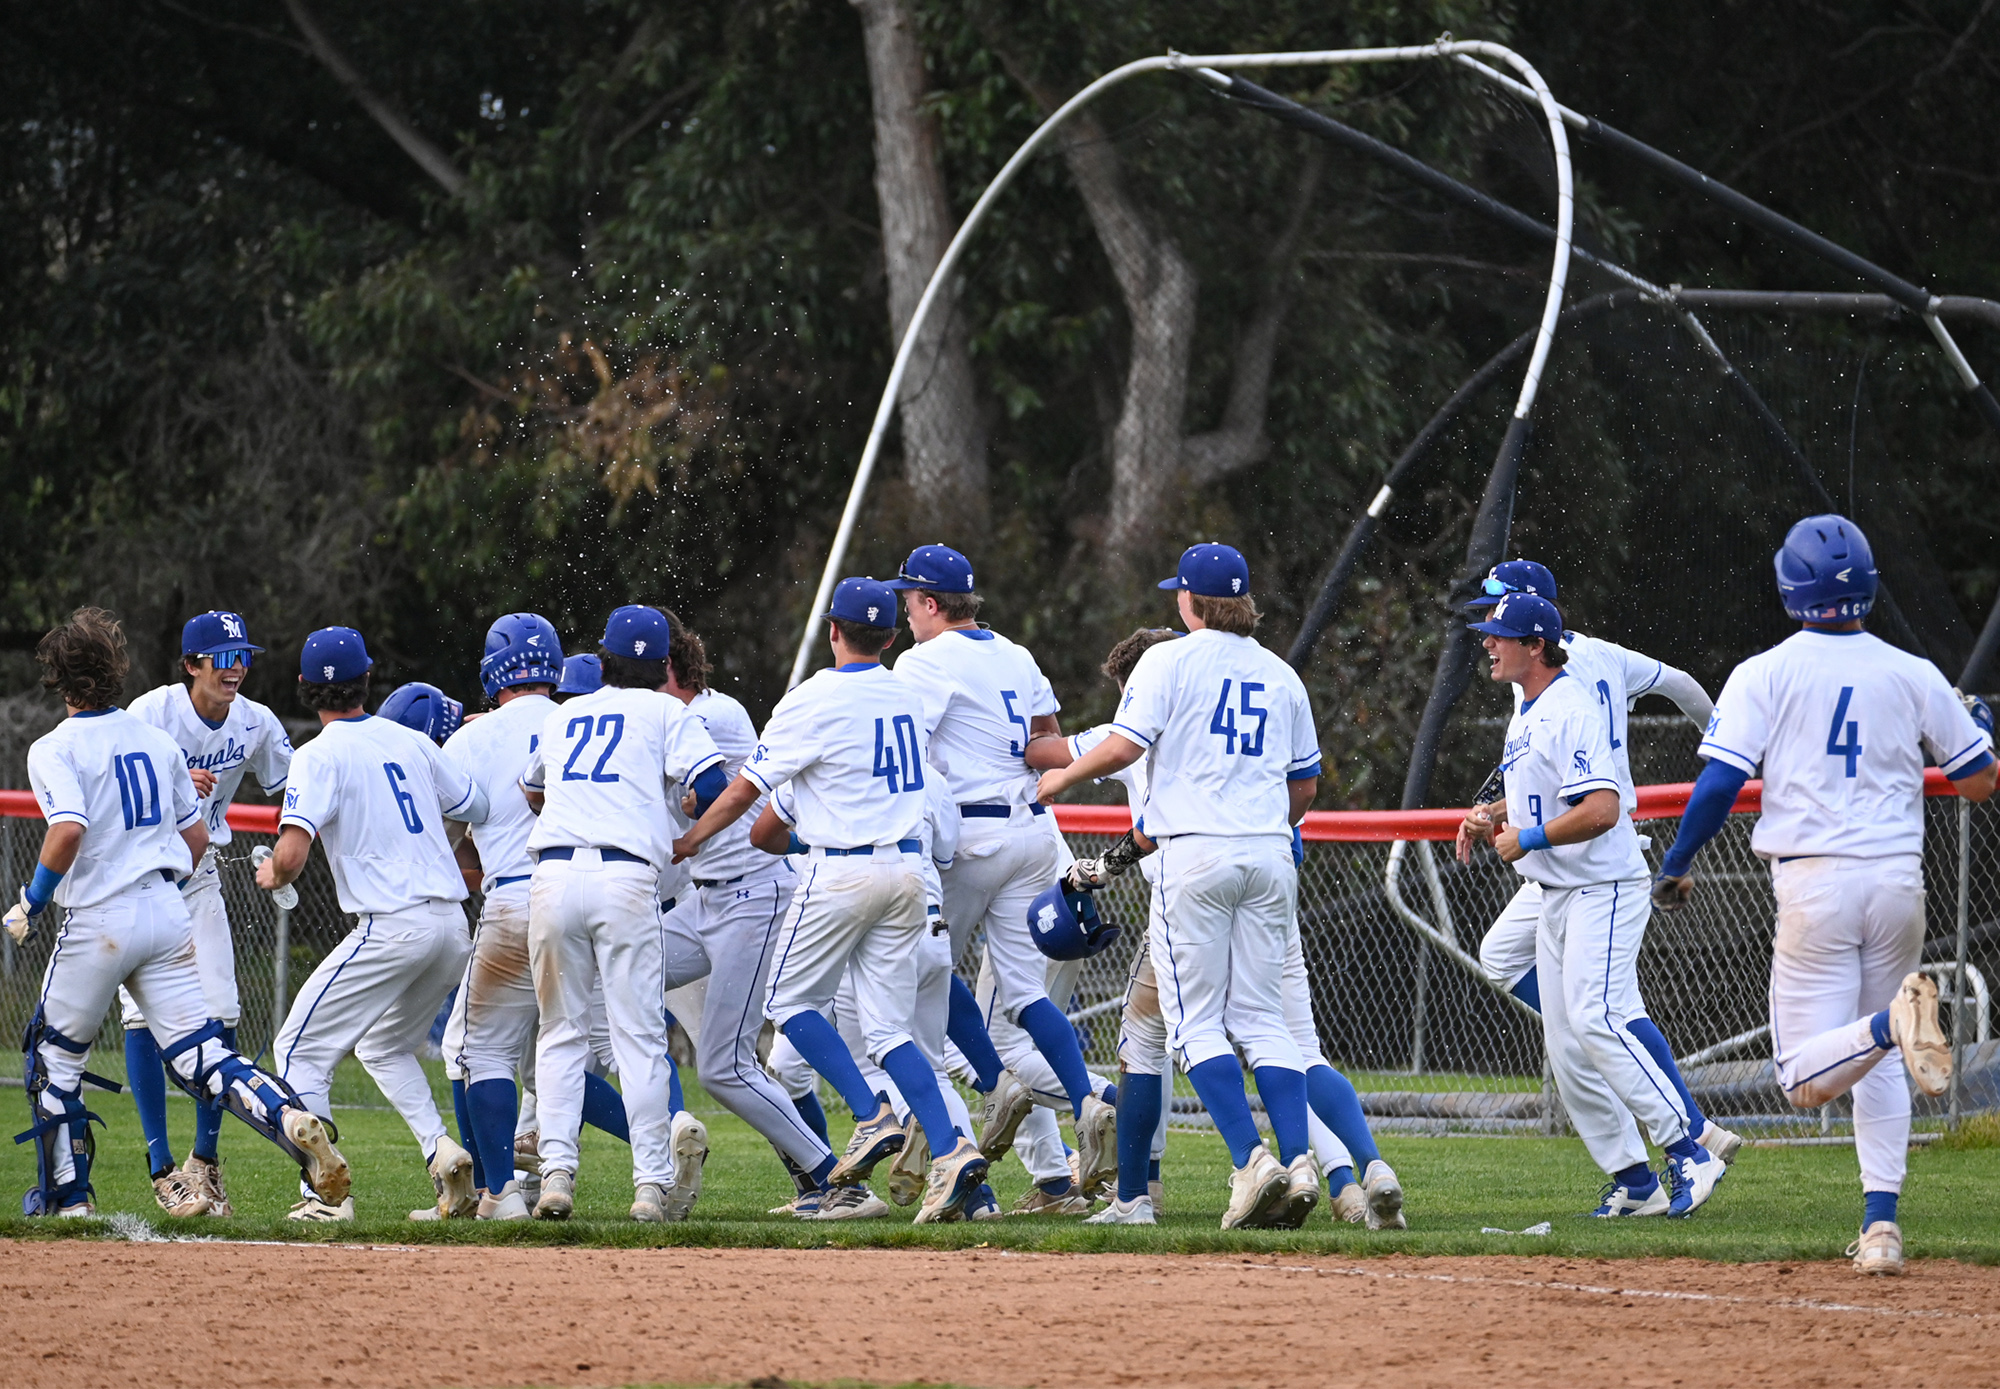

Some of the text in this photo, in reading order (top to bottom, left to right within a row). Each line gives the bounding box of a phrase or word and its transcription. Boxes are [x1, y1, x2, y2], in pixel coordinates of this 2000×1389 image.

[220, 614, 243, 638] SM
[1841, 604, 1848, 616] 4
[531, 667, 540, 677] 15
[1000, 690, 1028, 758] 5
[1210, 678, 1268, 757] 45
[1826, 686, 1863, 778] 4
[181, 737, 246, 774] oyals
[562, 713, 625, 783] 22
[872, 714, 925, 794] 40
[1573, 750, 1593, 777] SM
[114, 752, 162, 831] 10
[284, 787, 300, 810] SM
[383, 762, 424, 834] 6
[1528, 794, 1543, 827] 9
